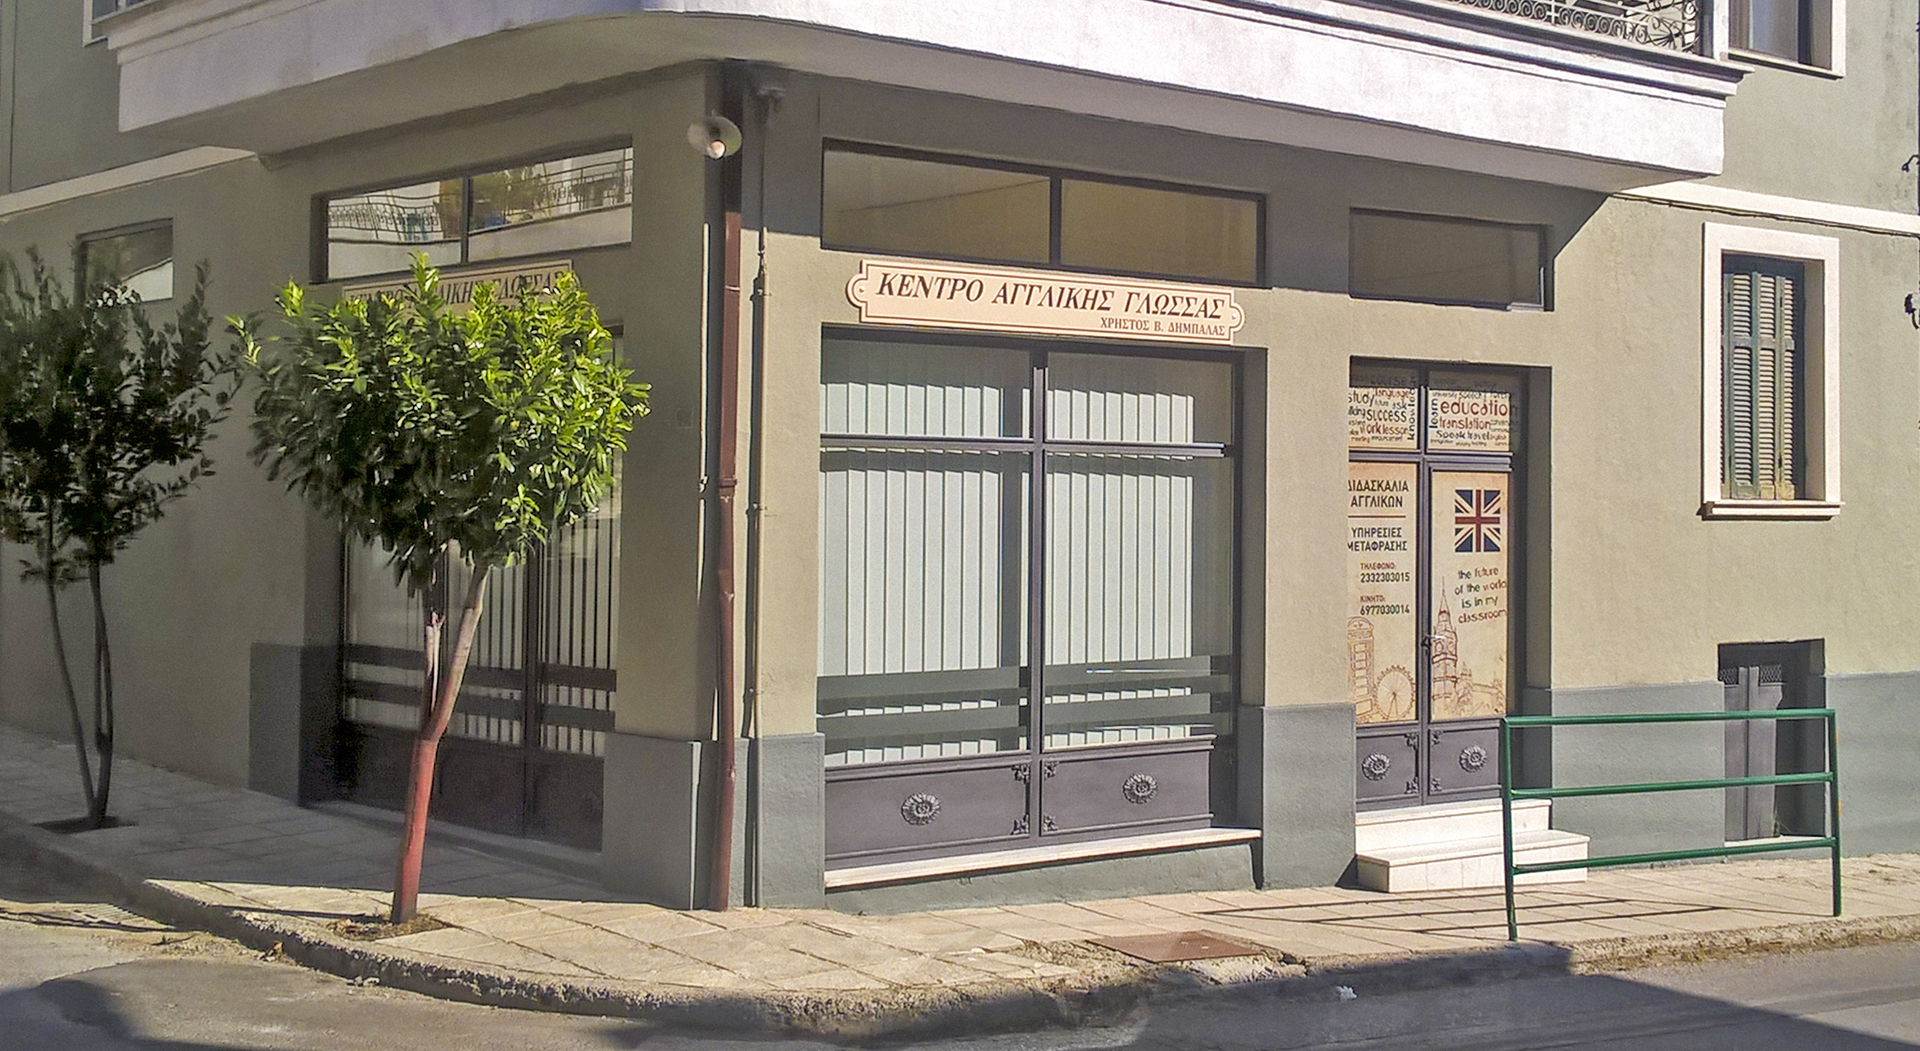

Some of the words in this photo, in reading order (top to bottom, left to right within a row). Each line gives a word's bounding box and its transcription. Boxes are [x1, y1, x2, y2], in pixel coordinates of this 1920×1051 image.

[876, 272, 984, 302] ΚΕΝΤΡΟ
[992, 282, 1115, 311] ΑΓΓΛΙΚΗΣ
[1124, 291, 1225, 320] ΓΛΩΣΣΑΣ
[1100, 317, 1150, 332] ΧΡΗΣΤΟΣ
[1154, 322, 1164, 333] Β.
[1168, 323, 1226, 337] ΔΗΜΠΑΛΑΣ
[1392, 399, 1408, 410] ask
[1366, 409, 1407, 423] success
[1428, 399, 1438, 429] learn
[1440, 416, 1491, 430] translation
[1467, 430, 1490, 440] travel
[1350, 495, 1403, 508] ΑΓΓΛΙΚΩΝ
[1351, 527, 1402, 538] ΥΠΗΡΕΣΙΕΣ
[1347, 541, 1407, 552] ΜΕΤΑΦΡΑΣΗΣ
[1360, 572, 1410, 583] 2332303015
[1458, 570, 1472, 579] the
[1474, 567, 1499, 578] future
[1454, 584, 1463, 595] of
[1466, 583, 1480, 593] the
[1461, 598, 1472, 609] is
[1474, 597, 1483, 607] in
[1485, 596, 1498, 606] my
[1360, 604, 1410, 616] 6977030014
[1458, 608, 1508, 624] classroom
